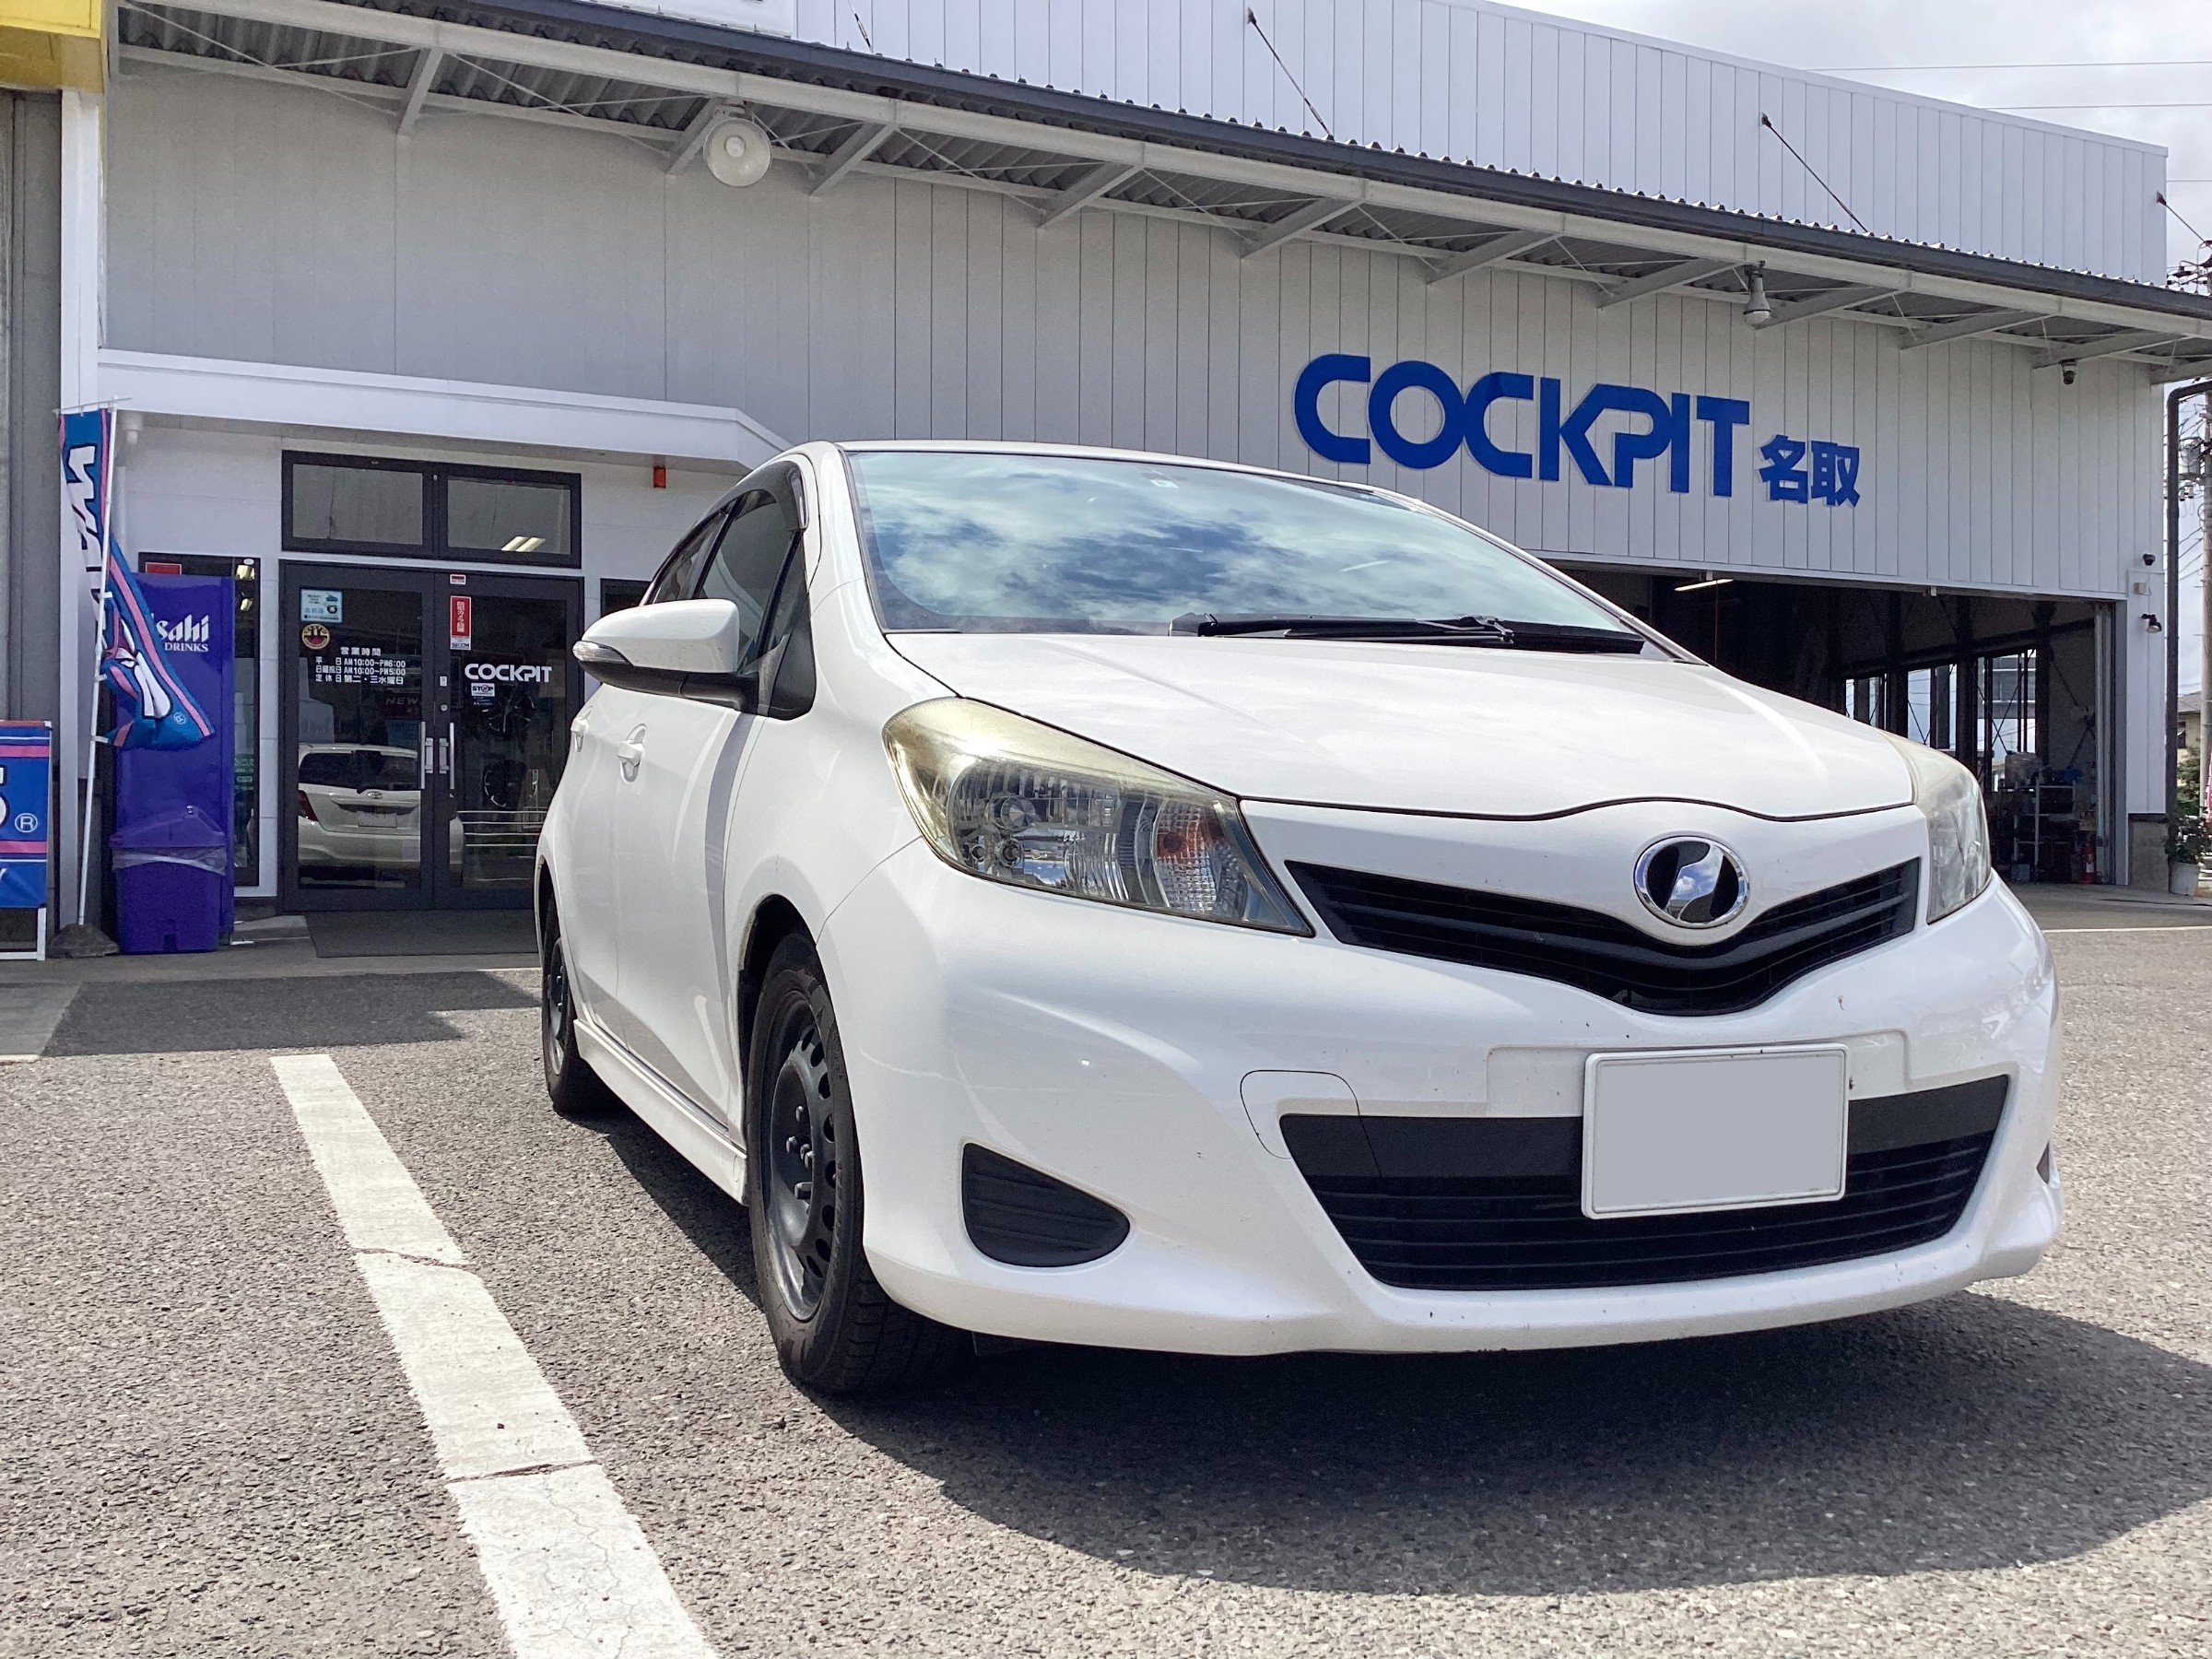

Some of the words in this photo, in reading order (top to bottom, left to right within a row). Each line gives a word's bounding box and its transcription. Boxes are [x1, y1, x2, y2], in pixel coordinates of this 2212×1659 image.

[1294, 353, 1749, 498] COCKPIT
[1758, 433, 1861, 509] 名取
[151, 613, 208, 642] sahi
[164, 642, 209, 653] DRINKS
[465, 664, 552, 682] COCKPIT
